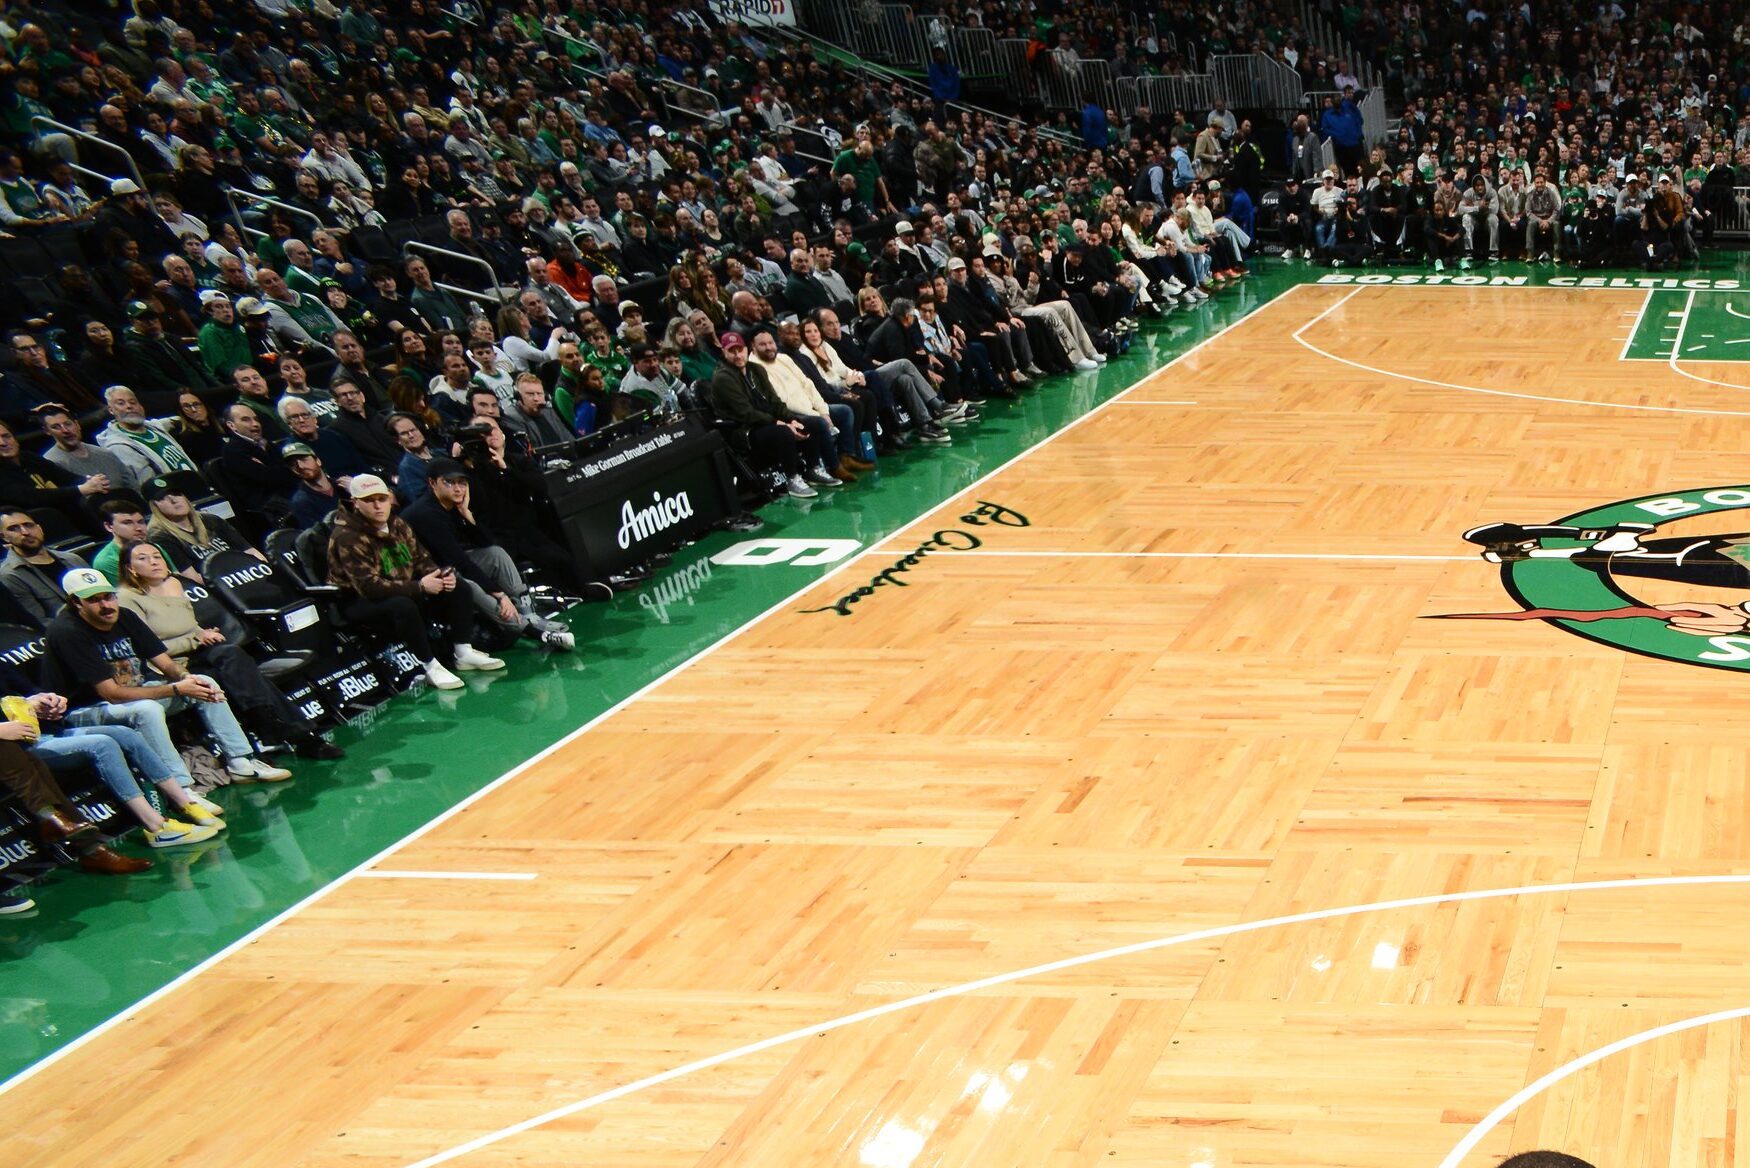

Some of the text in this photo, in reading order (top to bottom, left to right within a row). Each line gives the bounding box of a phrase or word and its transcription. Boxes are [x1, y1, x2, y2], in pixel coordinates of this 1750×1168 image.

[1316, 273, 1741, 289] BOSTON CELTICS
[581, 462, 600, 479] Mike
[597, 452, 627, 472] Gorman
[624, 440, 657, 462] Broadcast
[654, 432, 674, 450] Table
[618, 491, 694, 550] Amica
[220, 562, 273, 589] PIMCO
